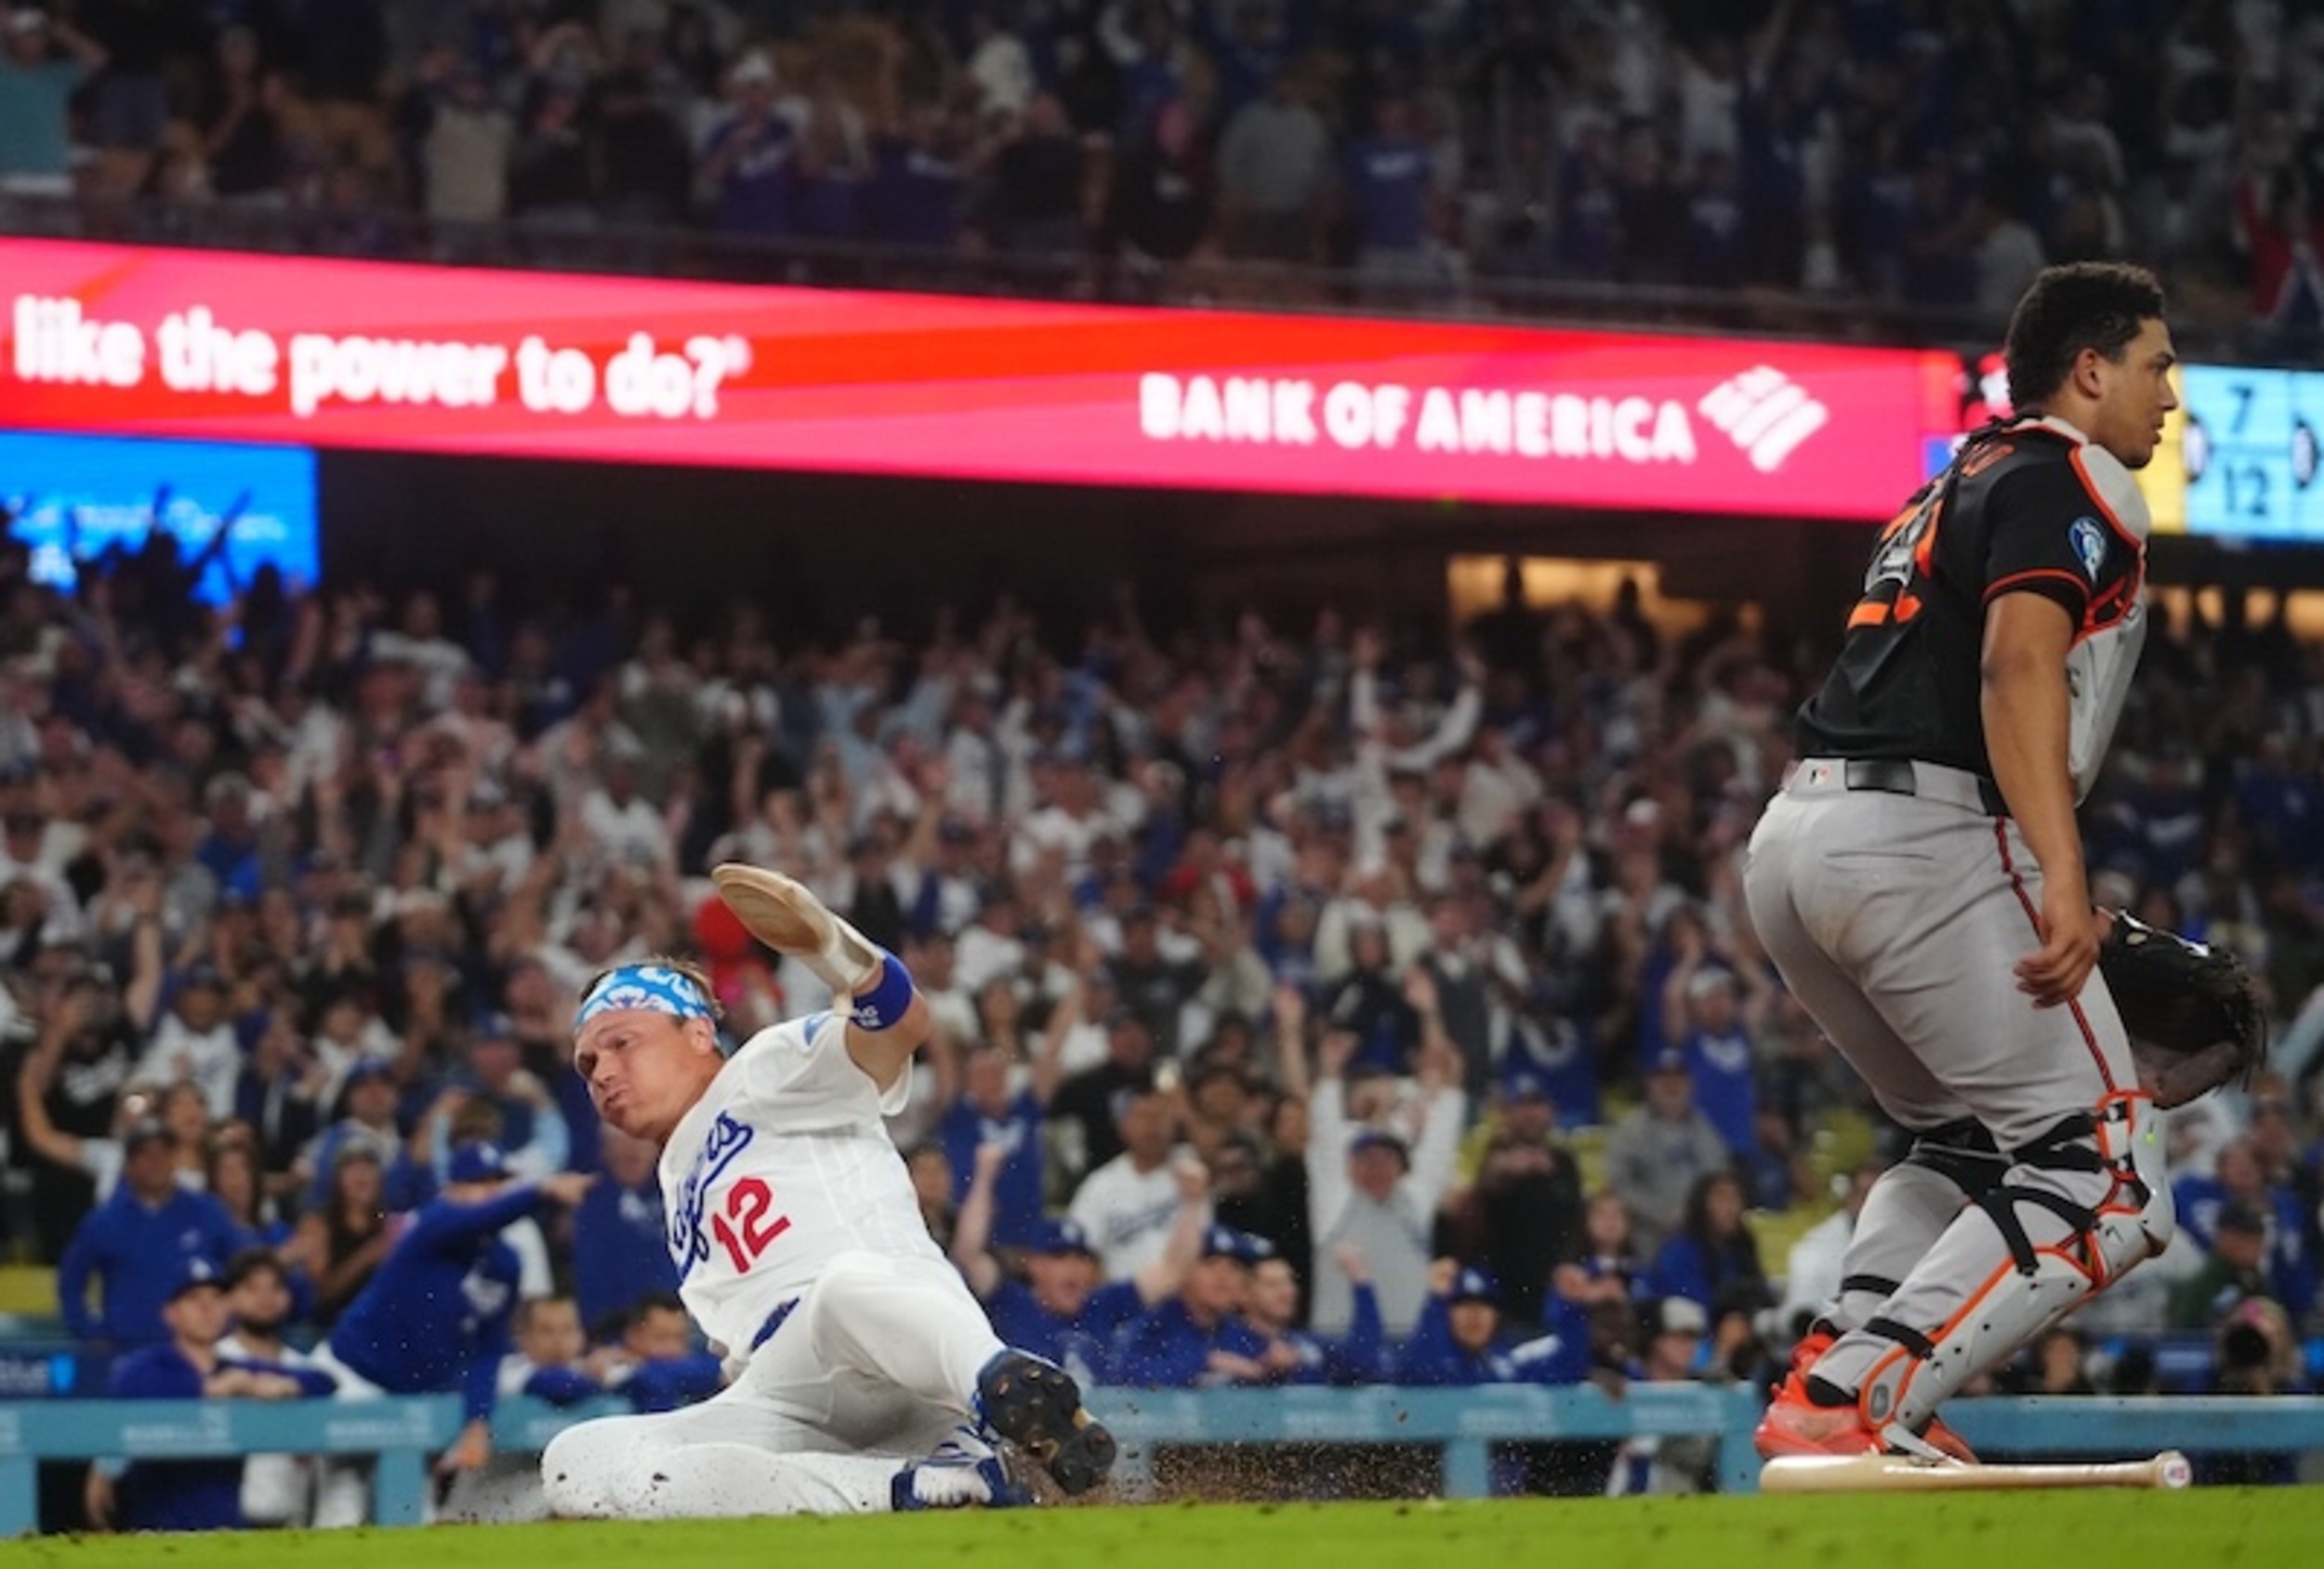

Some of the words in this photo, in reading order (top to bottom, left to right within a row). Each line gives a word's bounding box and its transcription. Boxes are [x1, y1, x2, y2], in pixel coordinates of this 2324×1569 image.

[13, 294, 145, 386] like
[155, 305, 278, 394] the
[289, 334, 507, 417] power
[516, 336, 595, 413] to
[1139, 373, 1317, 444] BANK
[1323, 381, 1410, 448] OF
[1416, 387, 1697, 462] AMERICA
[2227, 384, 2253, 435] 7
[2224, 465, 2268, 517] 12
[712, 1178, 791, 1274] 12
